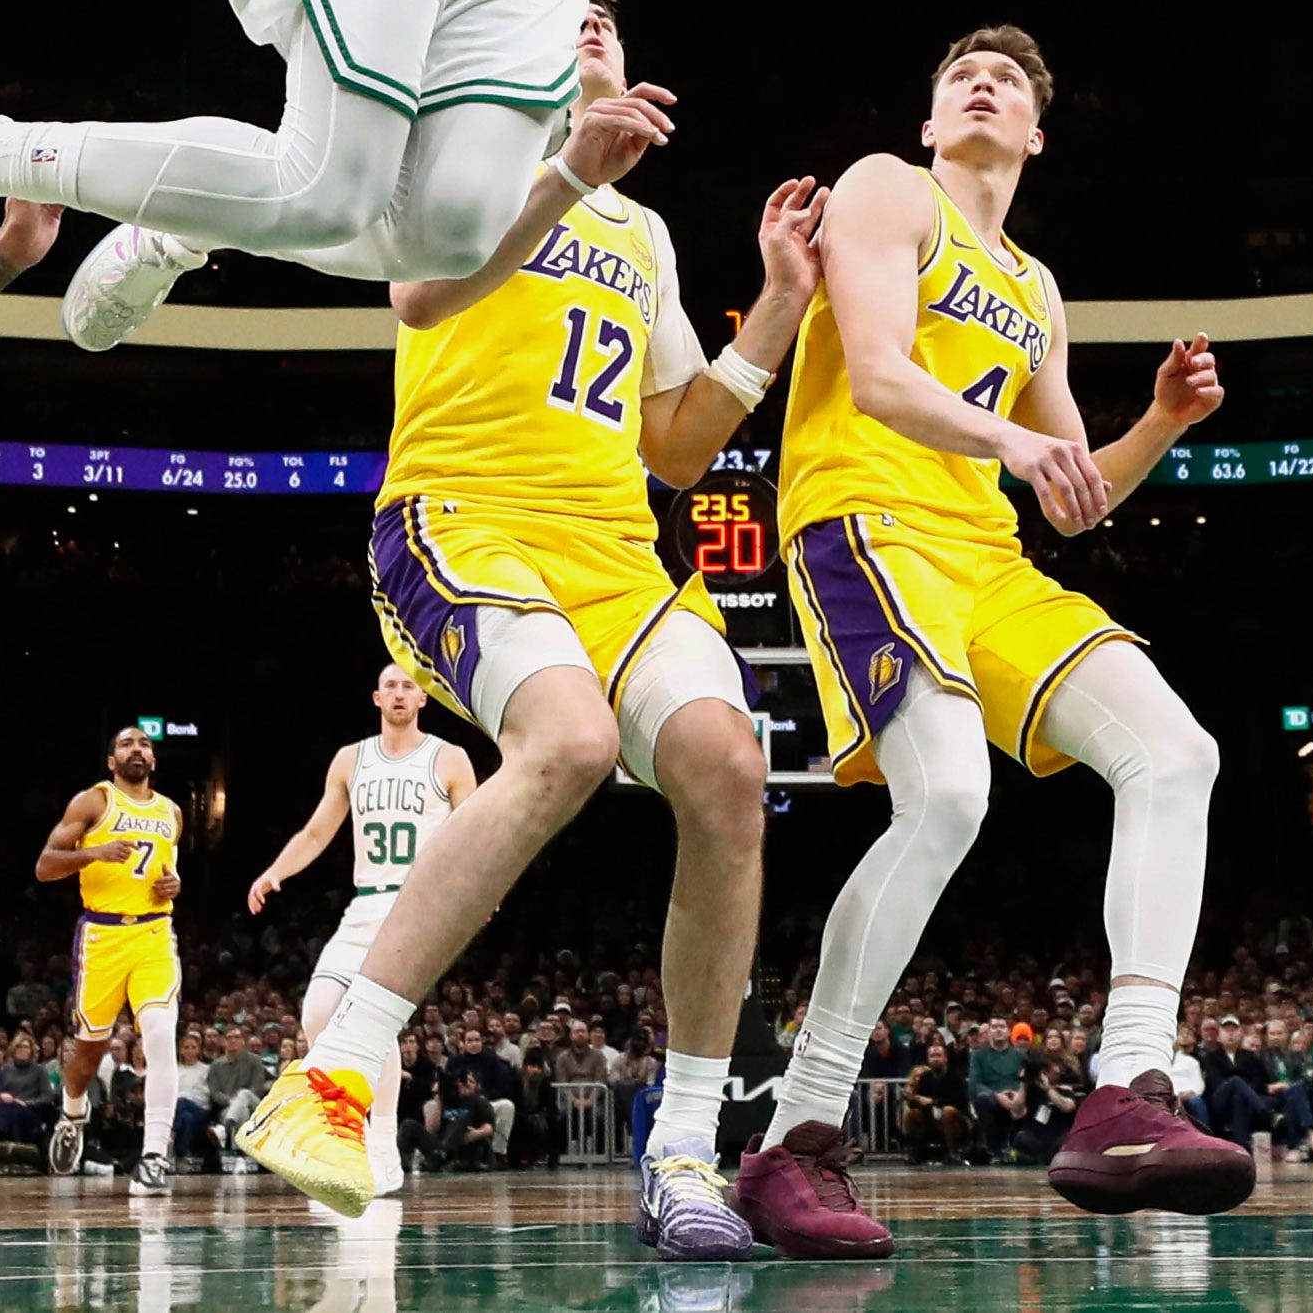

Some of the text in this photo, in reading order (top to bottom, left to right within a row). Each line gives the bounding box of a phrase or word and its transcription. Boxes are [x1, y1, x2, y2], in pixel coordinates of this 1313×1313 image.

[519, 224, 652, 325] LAKERS
[926, 261, 1048, 375] LAKERS
[547, 306, 635, 431] 12
[961, 365, 1011, 419] 4
[29, 447, 45, 458] TO
[89, 450, 110, 461] 3PT
[170, 454, 185, 464] FG
[228, 457, 254, 467] FG%
[282, 456, 303, 466] TOL
[329, 456, 347, 466] FLS
[710, 450, 771, 472] 23.7
[1171, 448, 1192, 458] TOL
[1215, 448, 1240, 458] FG%
[1284, 444, 1299, 454] FG
[32, 463, 43, 480] 3
[83, 465, 123, 483] 3/11
[162, 469, 203, 486] 6/24
[224, 471, 257, 489] 25.0
[288, 472, 300, 488] 6
[333, 471, 344, 487] 4
[1178, 463, 1189, 479] 6
[1212, 463, 1245, 479] 63.6
[692, 494, 750, 522] 23.5
[696, 523, 763, 572] 20
[710, 593, 776, 608] TISSOT
[167, 721, 198, 737] Bank
[771, 719, 796, 731] ank
[1286, 709, 1307, 726] TD
[356, 778, 426, 815] CELTICS
[110, 812, 173, 838] LAKERS
[363, 821, 417, 865] 30
[133, 839, 155, 878] 7
